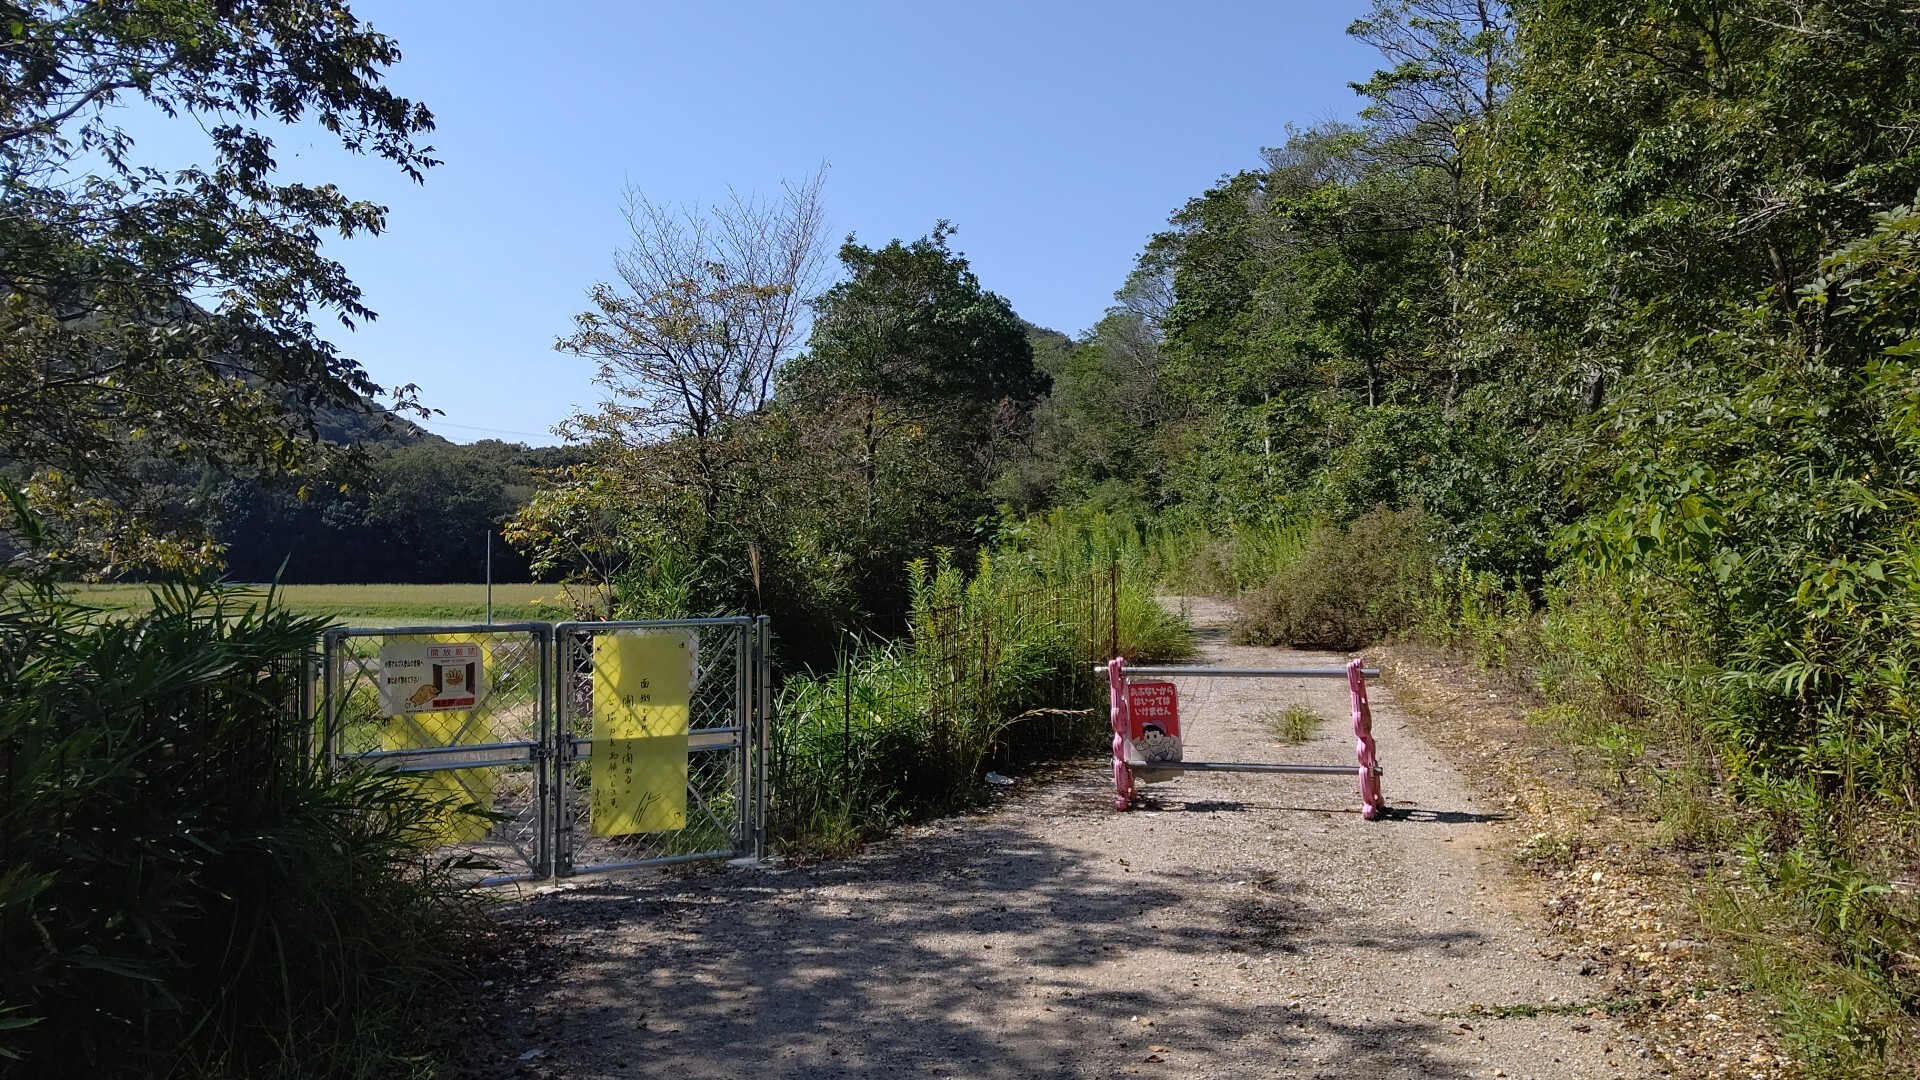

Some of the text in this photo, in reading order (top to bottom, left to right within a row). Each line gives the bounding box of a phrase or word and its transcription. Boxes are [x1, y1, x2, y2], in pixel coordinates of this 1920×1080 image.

[431, 647, 475, 657] 開放厳禁
[1130, 686, 1174, 697] あぶないから
[1134, 697, 1171, 706] はいっては
[1134, 707, 1172, 716] いけません
